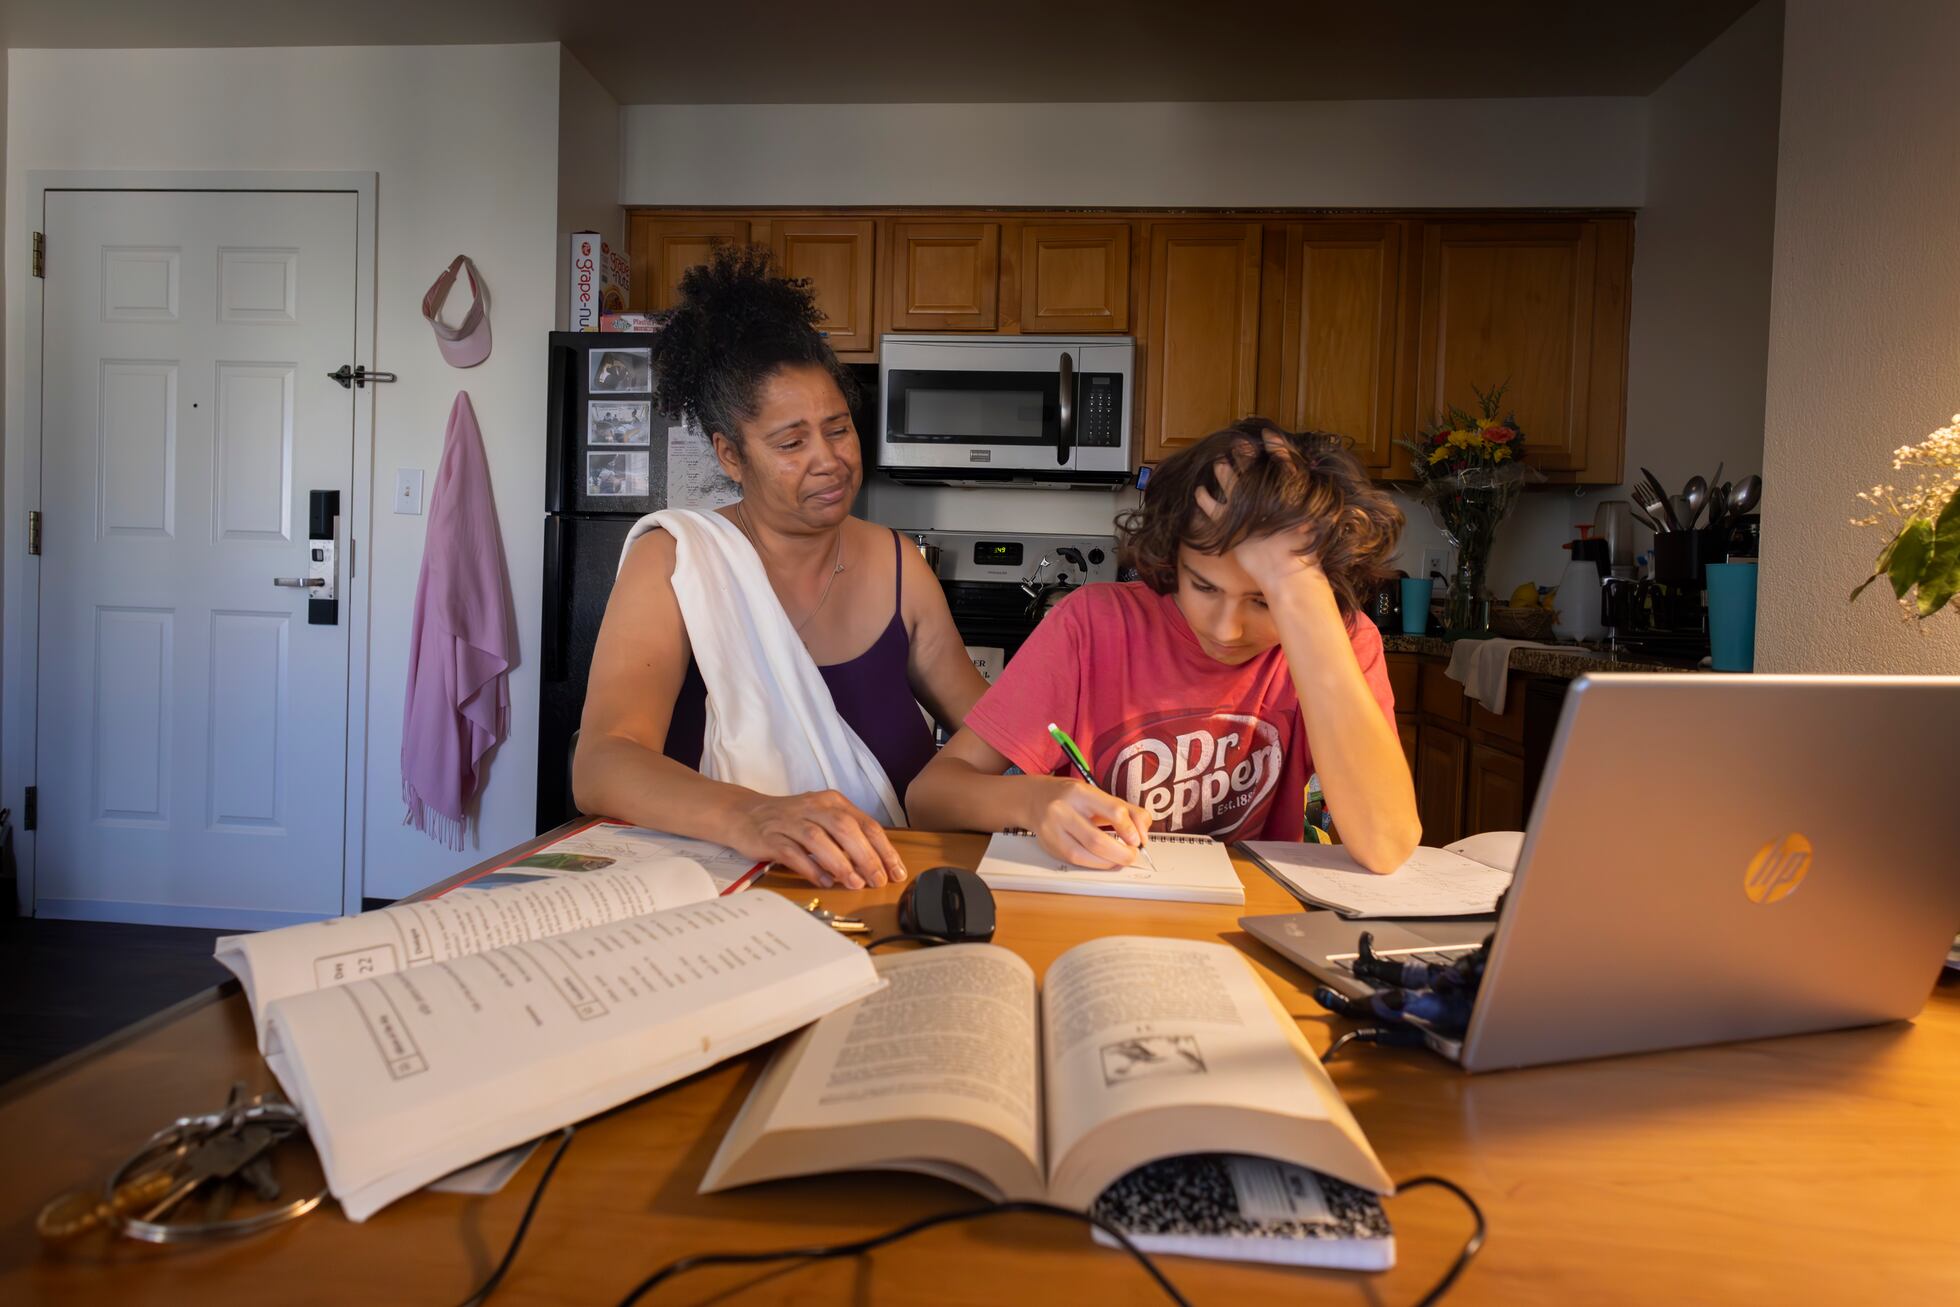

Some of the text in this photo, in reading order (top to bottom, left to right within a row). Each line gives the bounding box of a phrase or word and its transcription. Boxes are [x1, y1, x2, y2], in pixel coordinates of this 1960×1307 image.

[1111, 738, 1281, 831] Pepper
[1173, 730, 1239, 783] Dr
[1746, 834, 1812, 904] hp
